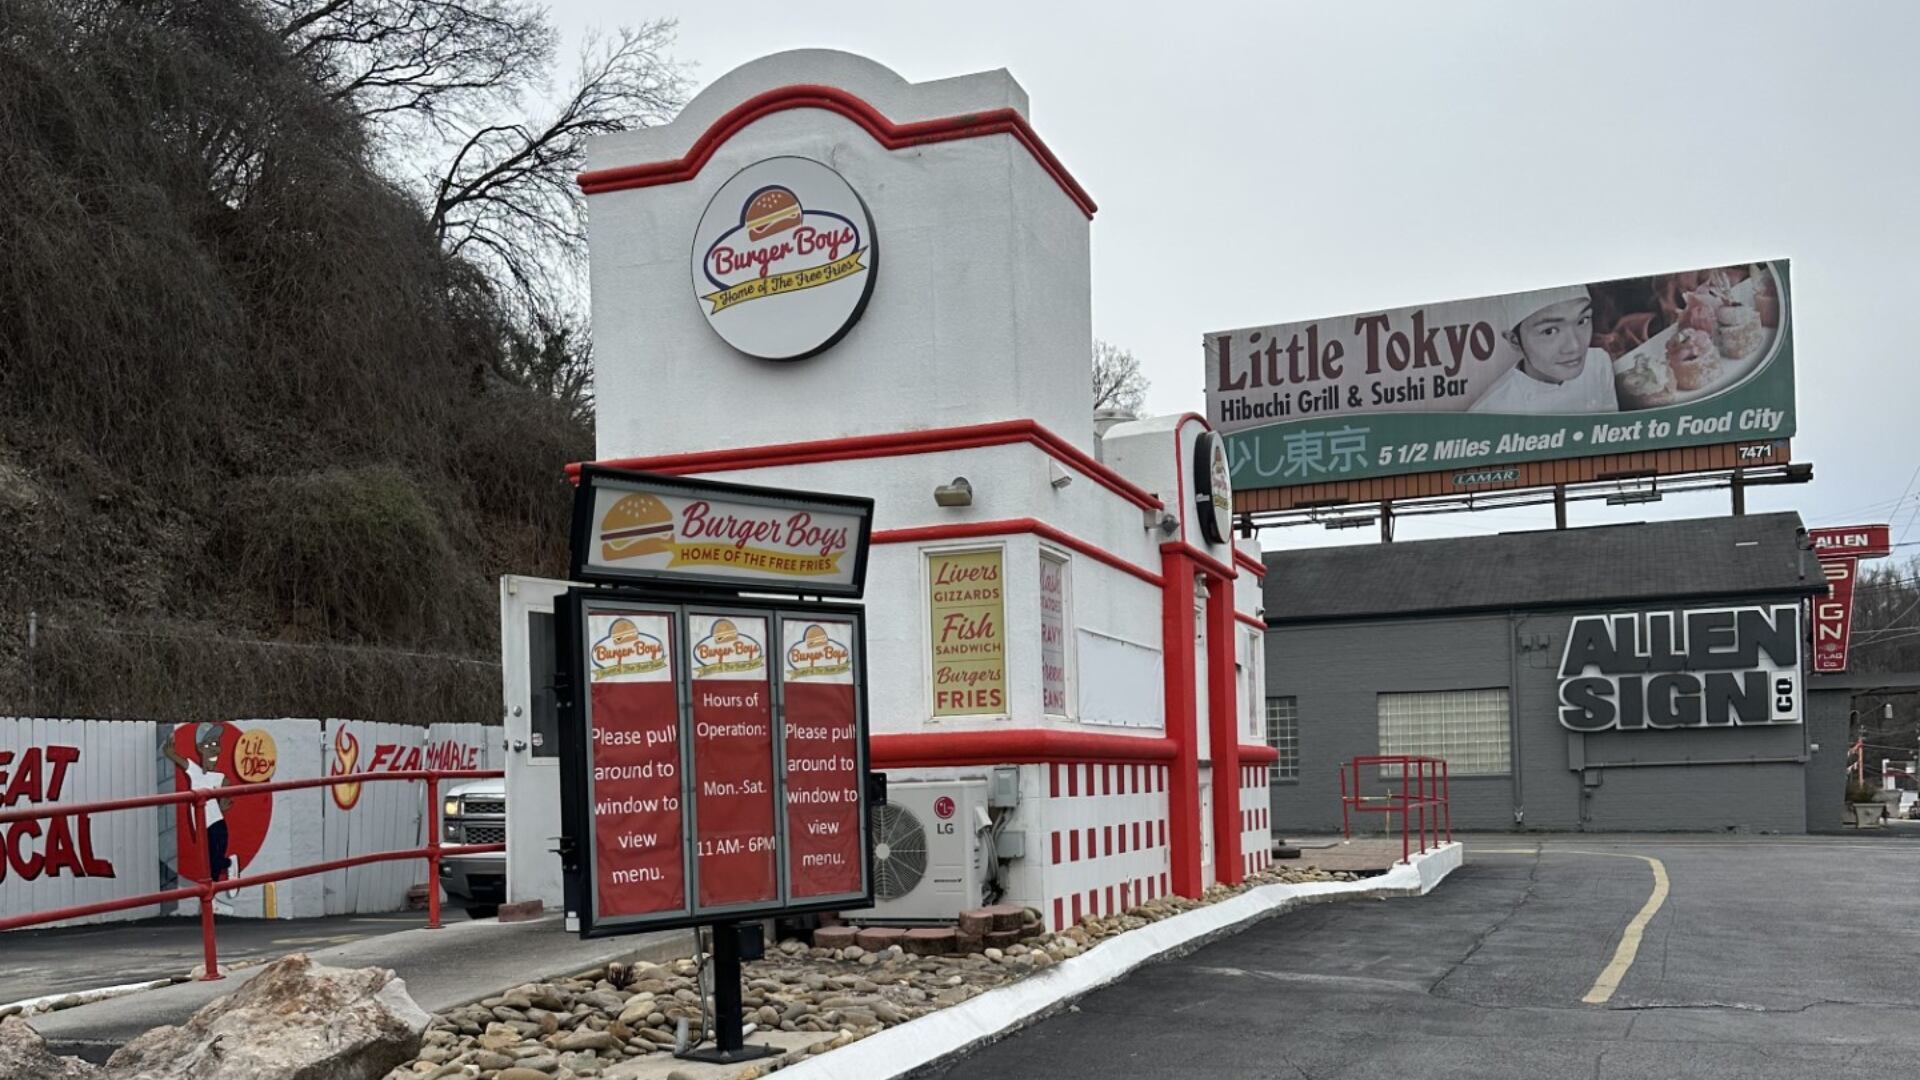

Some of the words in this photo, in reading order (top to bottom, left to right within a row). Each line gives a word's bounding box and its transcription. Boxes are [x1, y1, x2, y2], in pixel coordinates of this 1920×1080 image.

[712, 242, 793, 278] Burger
[793, 227, 854, 260] Boys
[720, 283, 754, 305] Home
[758, 279, 768, 294] of
[772, 278, 793, 292] The
[796, 271, 822, 286] Free
[824, 261, 853, 280] Fries
[1217, 324, 1344, 392] Little
[1354, 310, 1495, 377] Tokyo
[1221, 392, 1290, 422] Hibachi
[1300, 385, 1339, 413] Grill
[1347, 385, 1362, 407] &
[1372, 377, 1425, 406] Sushi
[1433, 375, 1468, 398] Bar
[1378, 446, 1393, 466] 5
[1398, 443, 1427, 464] 1/2
[1433, 438, 1490, 460] Miles
[1496, 429, 1565, 454] Ahead
[1591, 422, 1641, 444] Next
[1647, 419, 1670, 438] to
[1677, 412, 1732, 436] Food
[1740, 408, 1784, 432] City
[1740, 444, 1771, 459] 7471
[1458, 470, 1514, 484] LAMAR
[682, 501, 781, 549] Burger
[785, 512, 848, 557] Boys
[1816, 534, 1868, 548] ALLEN
[681, 548, 720, 561] HOME
[724, 550, 740, 562] OF
[744, 552, 766, 567] THE
[769, 557, 797, 570] FREE
[800, 559, 831, 571] FRIES
[935, 561, 997, 586] Livers
[934, 588, 999, 602] GIZZARDS
[1819, 563, 1848, 640] SIGN
[941, 612, 995, 643] Fish
[936, 643, 1000, 655] SANDWICH
[1557, 604, 1800, 677] ALLEN
[937, 666, 1000, 686] Burgers
[703, 693, 742, 707] Hours
[745, 693, 759, 707] of
[937, 689, 1001, 709] FRIES
[1558, 670, 1770, 731] SIGN
[592, 729, 641, 745] Please
[697, 722, 767, 740] Operation:
[785, 724, 827, 740] Please
[594, 760, 652, 780] around
[656, 762, 674, 777] to
[788, 754, 836, 771] around
[841, 756, 854, 770] to
[704, 780, 767, 796] Mon.-Sat.
[787, 788, 840, 804] window
[844, 788, 858, 801] to
[594, 797, 658, 815] window
[663, 795, 679, 811] to
[808, 820, 839, 834] view
[936, 823, 954, 835] LG
[618, 831, 657, 848] view
[749, 836, 776, 852] 6PM
[0, 813, 116, 885] CAL
[803, 853, 845, 867] menu.
[612, 867, 665, 884] menu.
